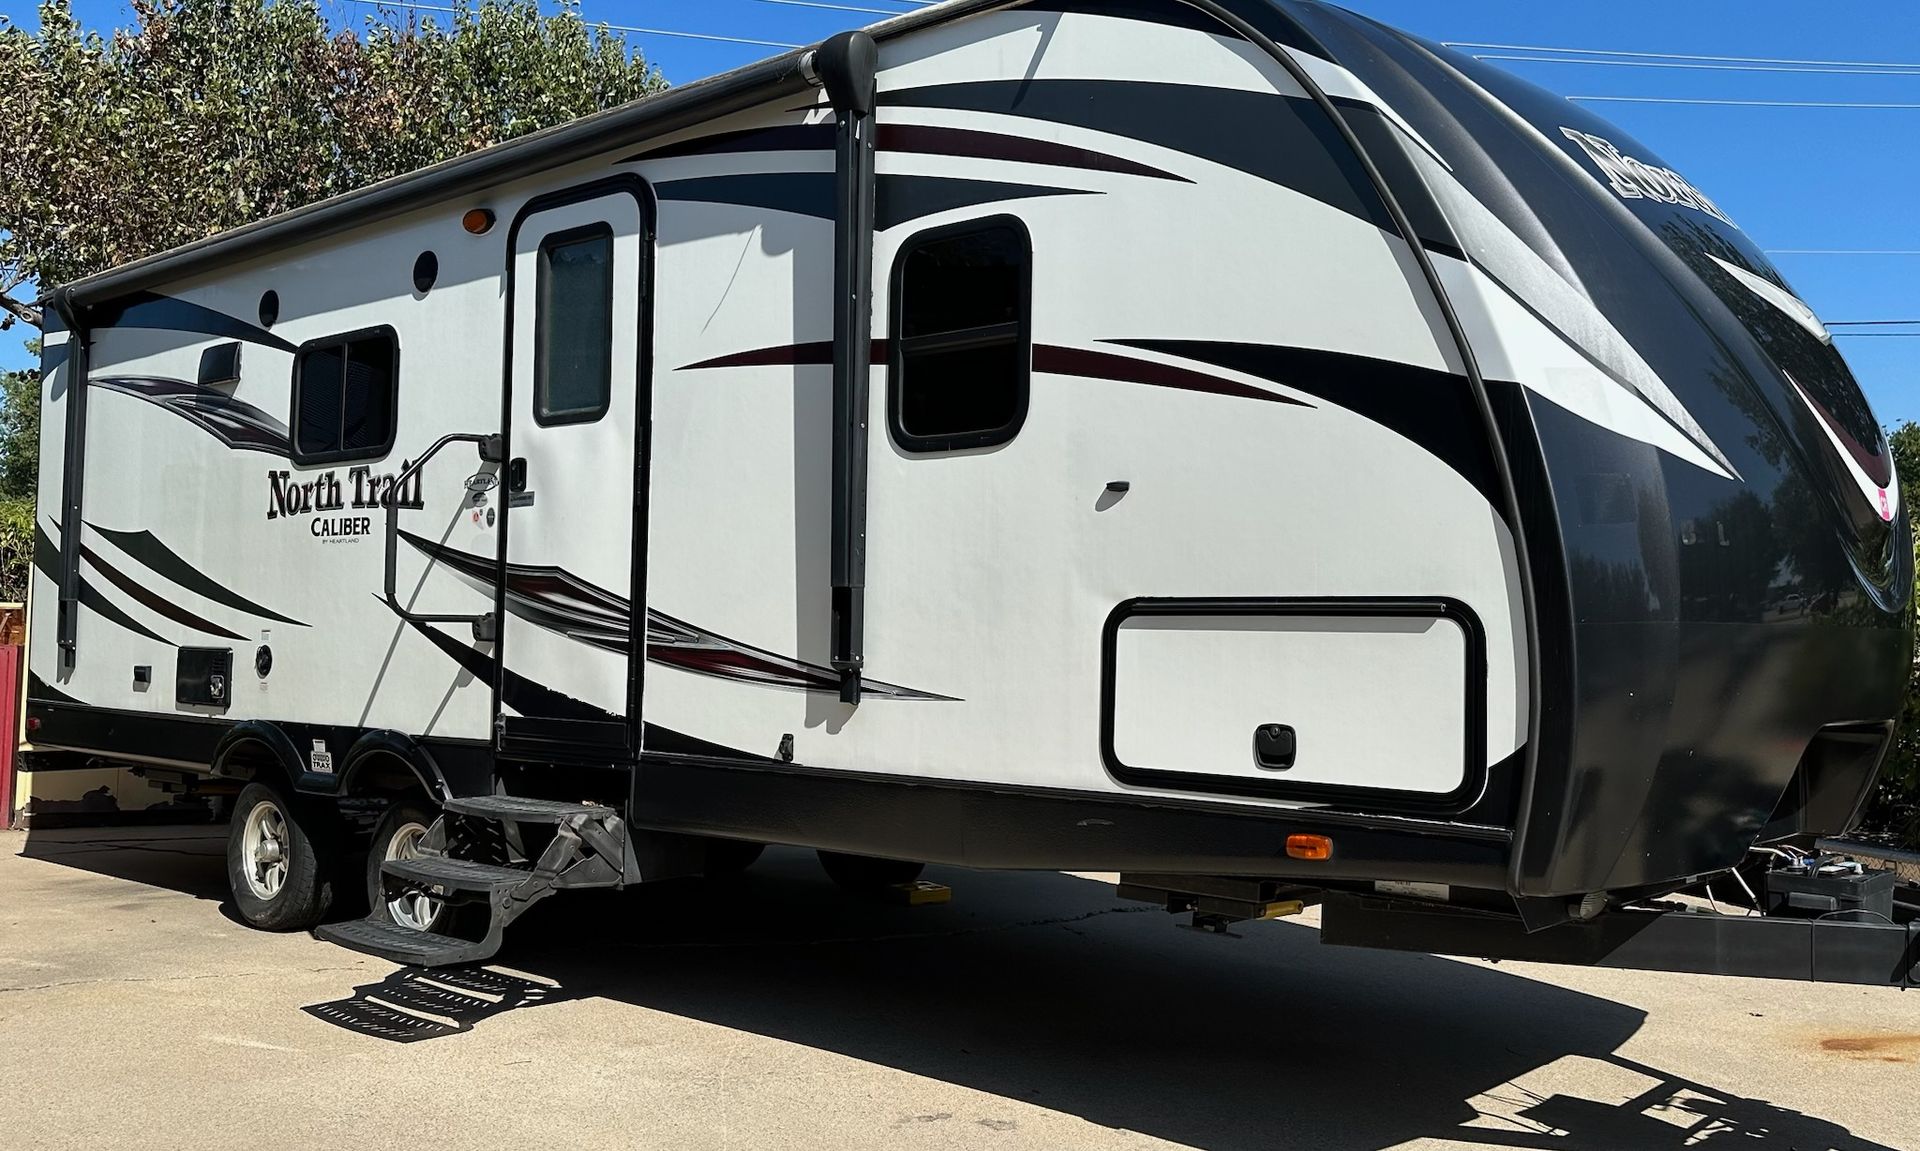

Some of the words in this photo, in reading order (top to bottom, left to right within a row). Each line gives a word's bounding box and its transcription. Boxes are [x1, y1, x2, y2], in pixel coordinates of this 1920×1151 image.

[267, 470, 344, 520] North
[348, 458, 424, 510] Trail
[311, 517, 370, 536] CALIBER
